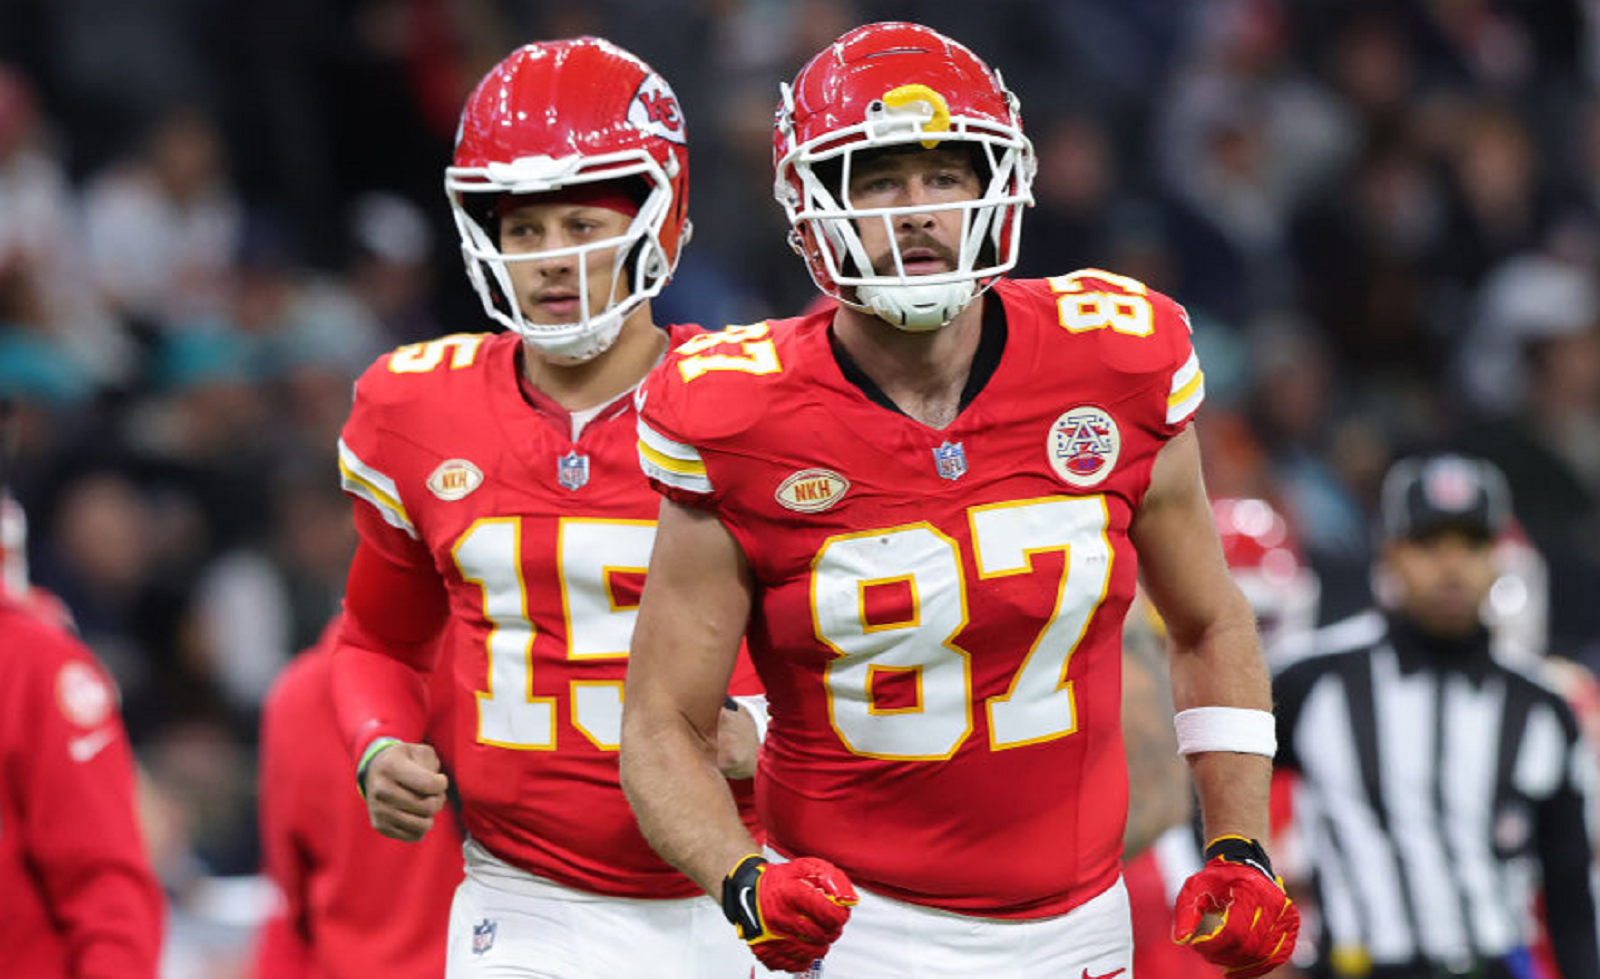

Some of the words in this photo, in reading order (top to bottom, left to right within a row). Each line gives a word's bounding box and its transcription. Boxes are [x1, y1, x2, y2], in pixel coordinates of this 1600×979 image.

[1049, 268, 1155, 337] 87
[674, 323, 783, 383] 87
[442, 470, 467, 490] NKH
[794, 479, 831, 502] NKH
[452, 516, 659, 751] 15
[810, 494, 1114, 761] 87
